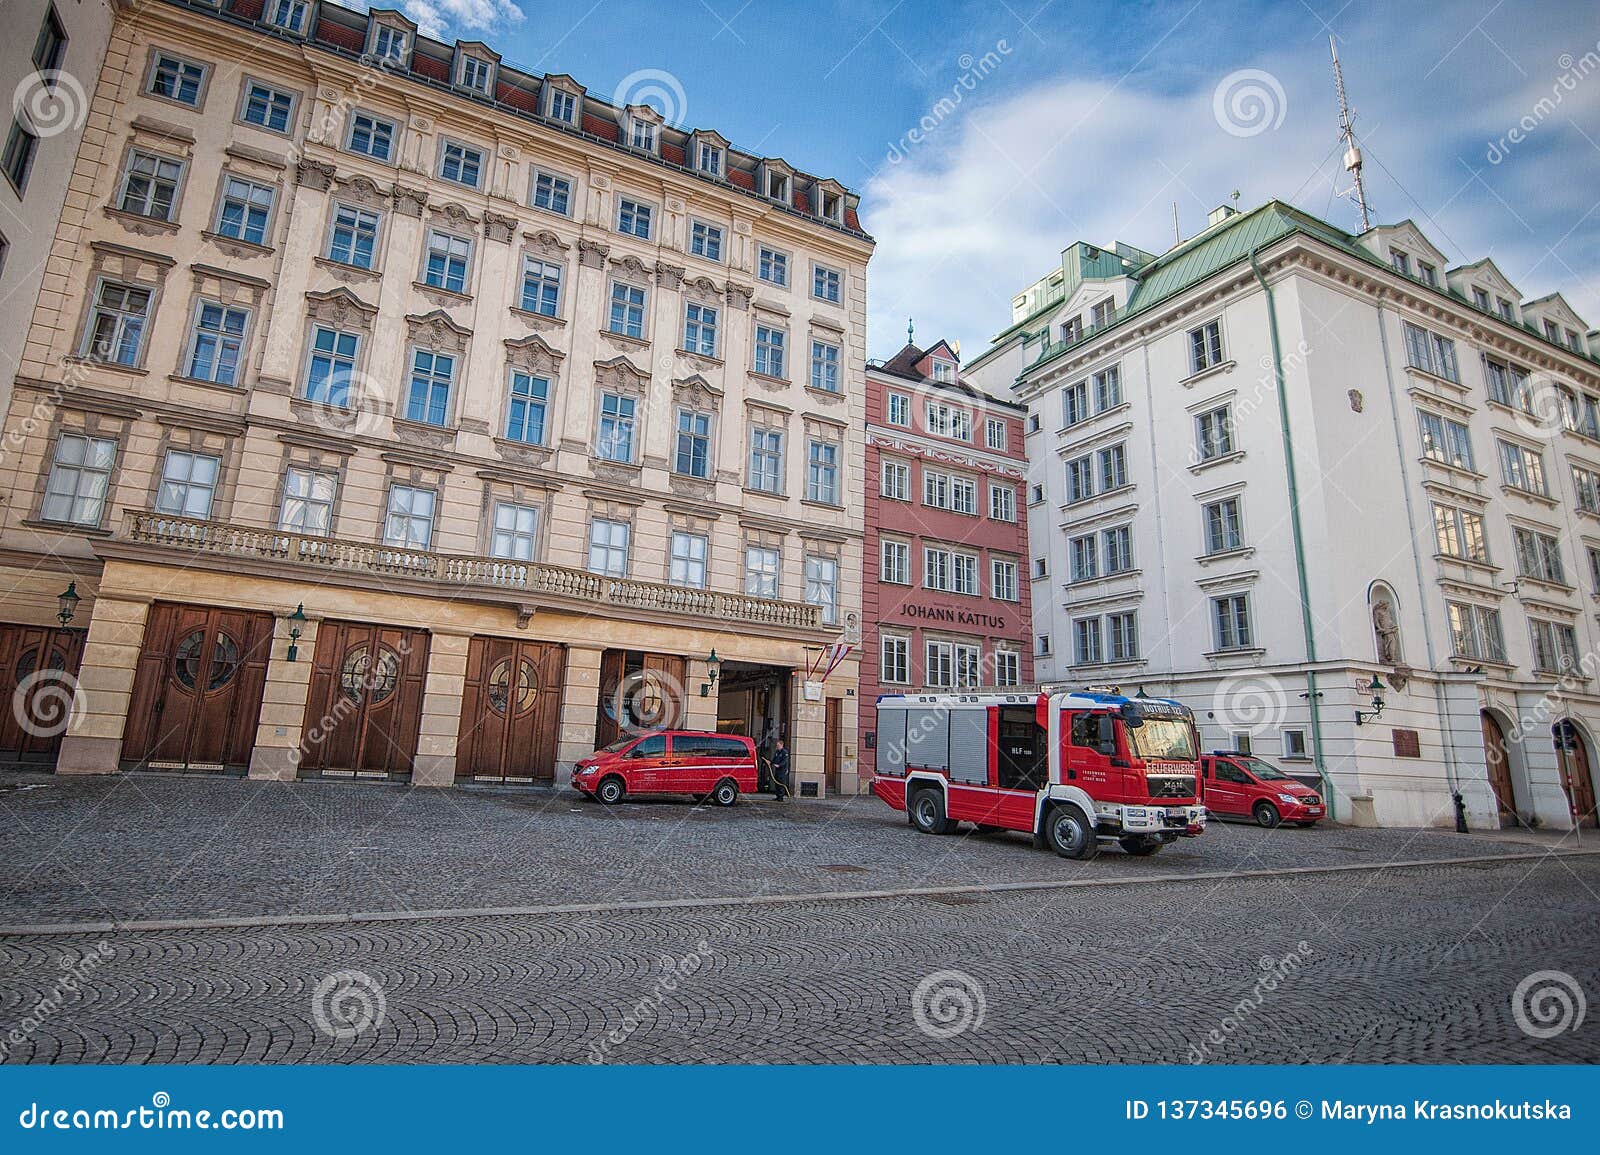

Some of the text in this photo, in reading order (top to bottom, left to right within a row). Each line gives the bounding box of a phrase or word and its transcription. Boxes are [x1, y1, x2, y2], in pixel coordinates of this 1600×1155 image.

[900, 603, 954, 622] JOHANN
[958, 611, 1005, 629] KATTUS
[1143, 703, 1170, 714] NOTRUF
[1146, 762, 1196, 775] FEUERWEHR
[1164, 781, 1183, 789] MAN
